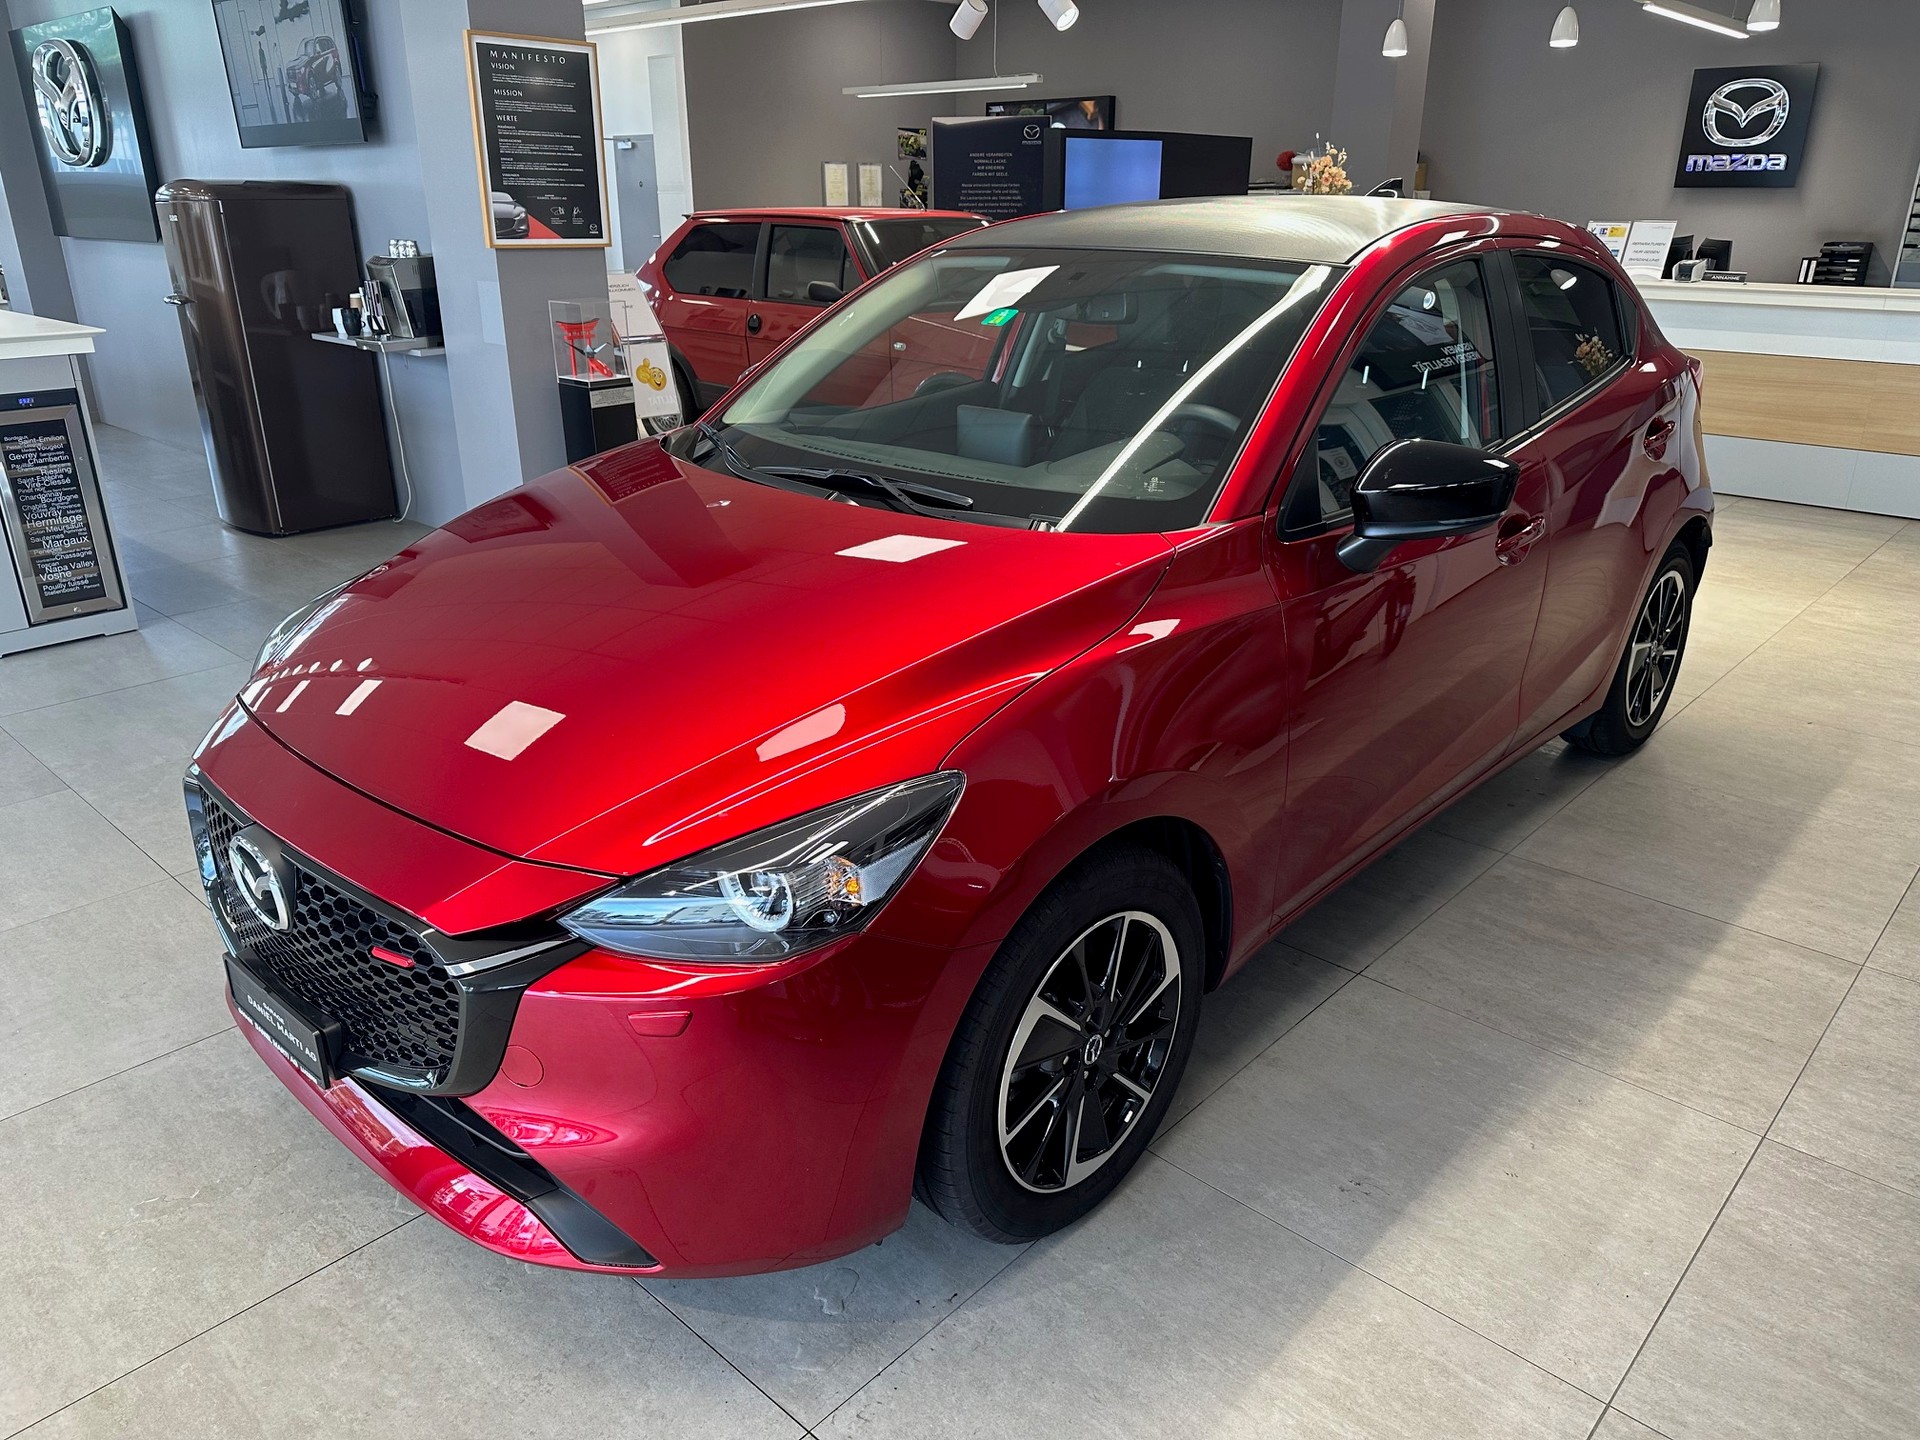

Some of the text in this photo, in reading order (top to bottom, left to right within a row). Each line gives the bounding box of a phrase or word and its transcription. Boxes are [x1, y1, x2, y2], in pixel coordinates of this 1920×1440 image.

[489, 50, 566, 64] MANIFESTO
[490, 62, 515, 70] VISION
[493, 89, 523, 97] MISSION
[1685, 153, 1788, 172] mazda
[8, 452, 38, 461] Gevrey
[28, 454, 70, 464] Chambertin
[20, 491, 63, 502] Chardonnay
[40, 494, 79, 504] Bourgogne
[23, 509, 62, 520] Vouvray
[26, 514, 83, 529] Hermitage
[30, 533, 64, 543] Sauternes
[42, 536, 90, 549] Margaux
[45, 561, 95, 574] Napa Valley
[39, 570, 72, 582] Vosne
[247, 994, 317, 1062] DANIEL MARTI AG
